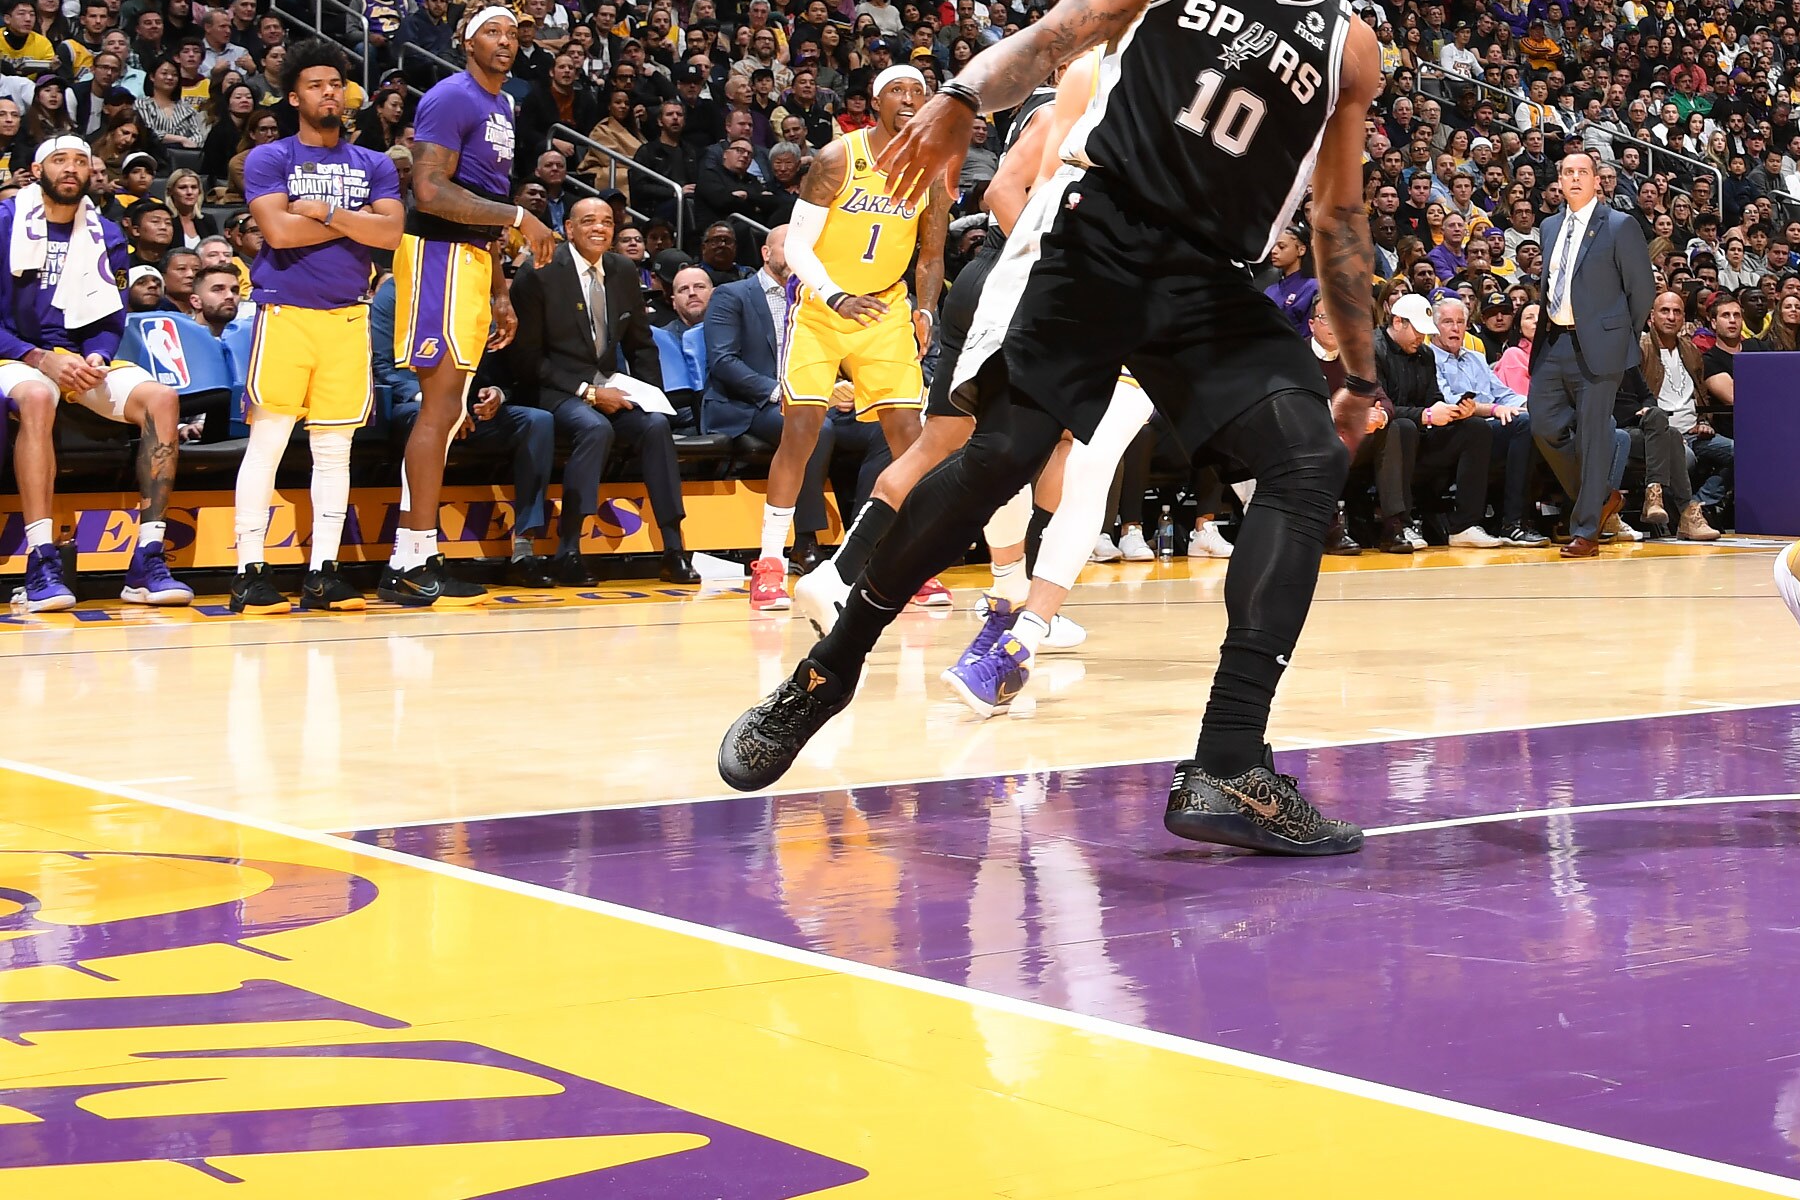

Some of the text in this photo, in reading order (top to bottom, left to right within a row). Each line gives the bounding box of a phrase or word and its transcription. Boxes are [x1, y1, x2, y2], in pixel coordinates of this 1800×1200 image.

[1293, 20, 1326, 50] Frost
[1174, 67, 1269, 158] 10
[288, 179, 332, 196] QUALITY
[862, 224, 881, 261] 1
